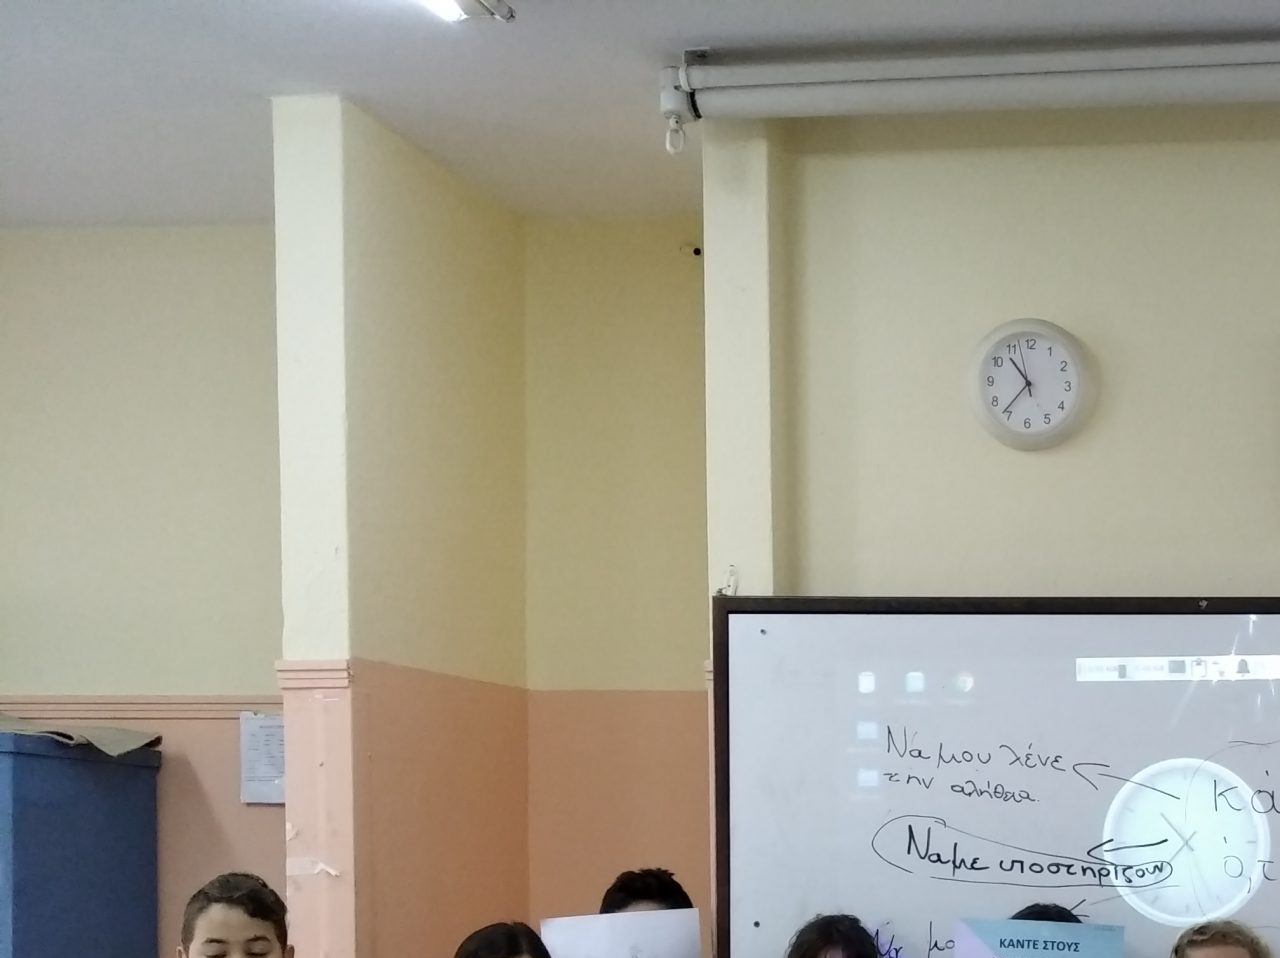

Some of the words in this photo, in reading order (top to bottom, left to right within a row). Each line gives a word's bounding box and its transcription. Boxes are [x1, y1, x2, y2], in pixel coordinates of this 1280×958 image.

[1006, 344, 1017, 354] 11
[1025, 339, 1037, 350] 12
[1047, 347, 1053, 356] 1
[992, 356, 1003, 367] 10
[1060, 361, 1068, 372] 2
[987, 376, 994, 386] 9
[1064, 381, 1072, 392] 3
[991, 396, 999, 407] 8
[1058, 401, 1065, 411] 4
[1006, 411, 1013, 421] 7
[1044, 414, 1051, 424] 5
[1024, 418, 1031, 429] 6
[1000, 743, 1066, 771] λένε
[999, 938, 1039, 950] ΚΑΝΤΕ
[1042, 940, 1080, 952] ΣΤΟΥΣ
